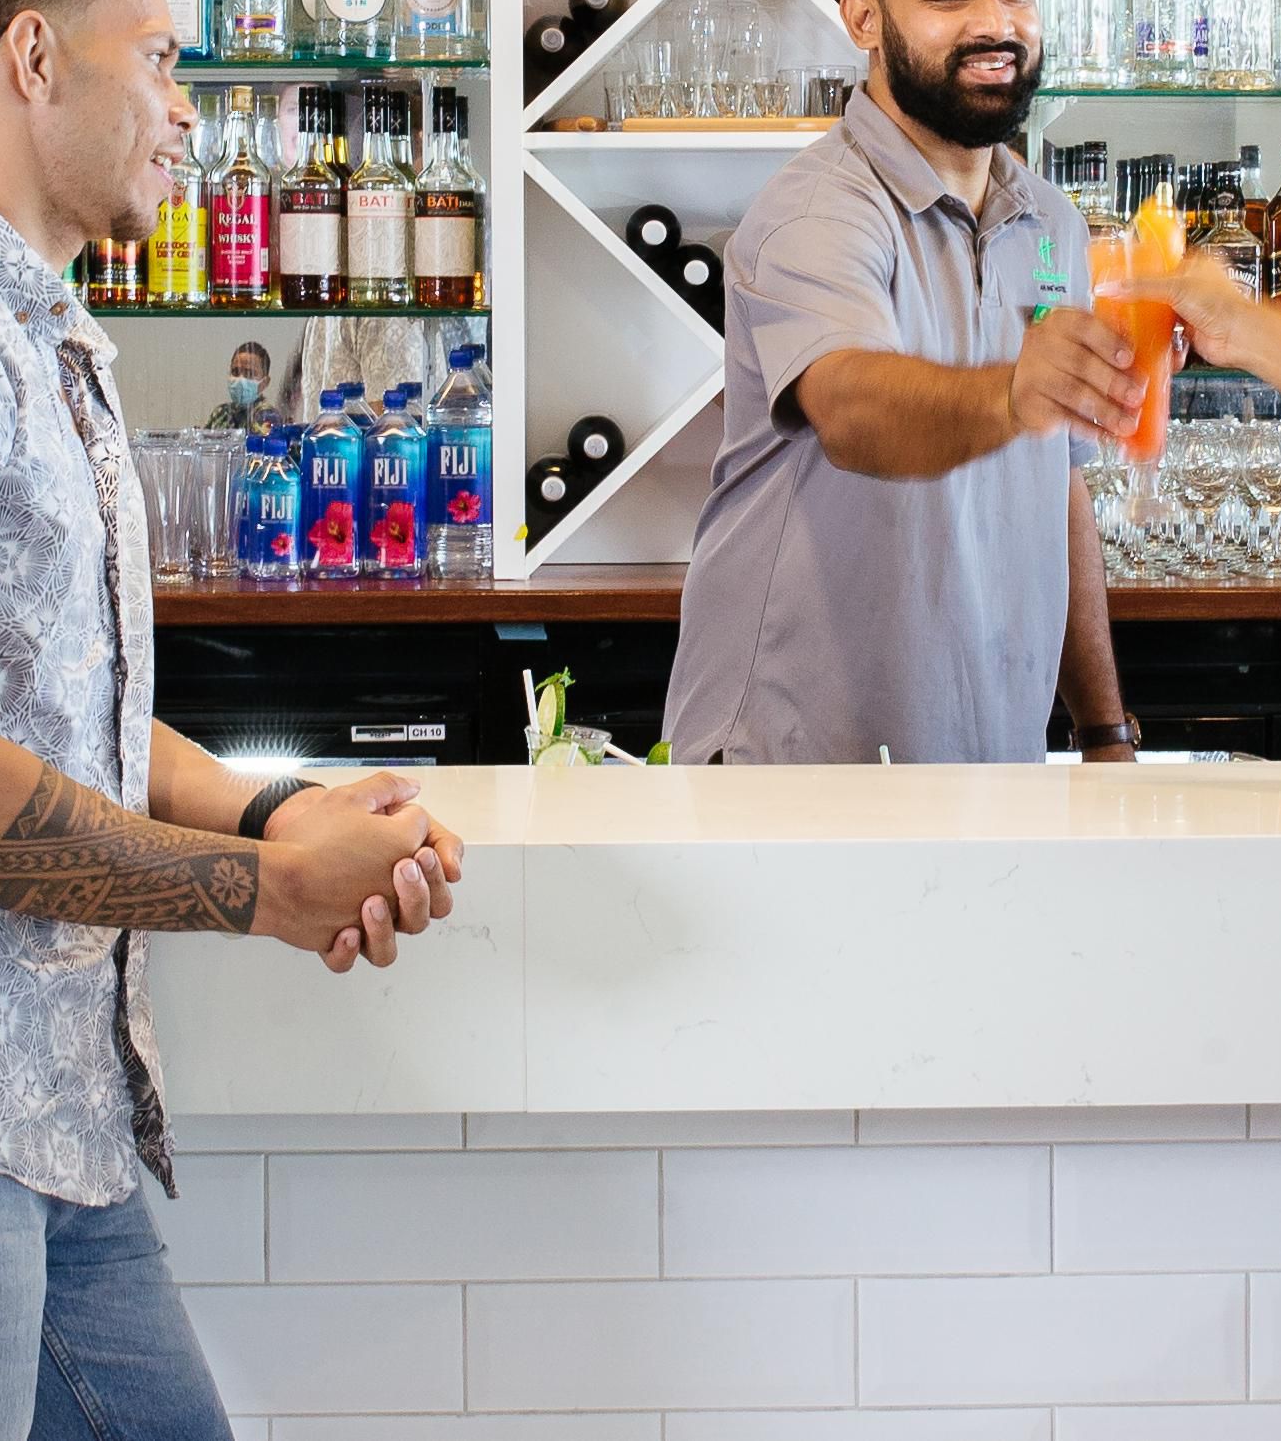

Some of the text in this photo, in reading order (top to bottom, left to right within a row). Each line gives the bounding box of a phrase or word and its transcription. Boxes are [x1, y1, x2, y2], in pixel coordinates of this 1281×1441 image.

[345, 0, 367, 7] GIN
[292, 192, 329, 205] BATI
[359, 195, 393, 207] BAT
[427, 195, 459, 208] BATI
[219, 213, 257, 226] REGAL
[219, 233, 257, 244] WHISKY
[156, 250, 175, 258] DRY
[1228, 266, 1259, 289] DANIEL
[440, 446, 478, 476] FIJI
[312, 457, 347, 486] FIJI
[374, 457, 407, 486] FIJI
[260, 494, 293, 520] FIJI
[412, 727, 441, 737] CH 10
